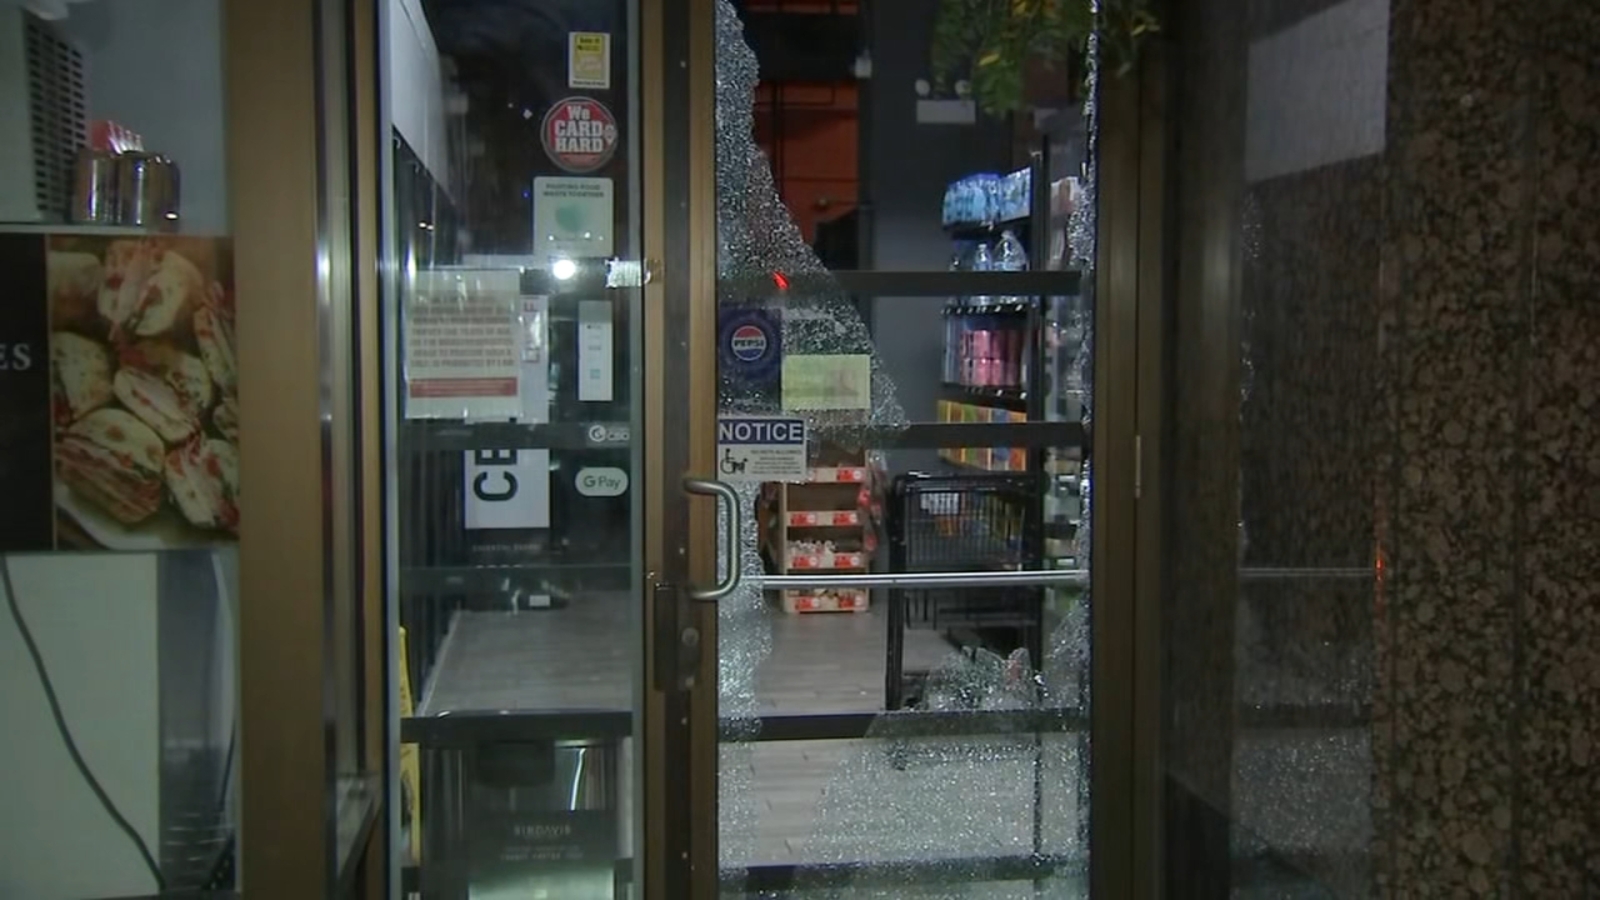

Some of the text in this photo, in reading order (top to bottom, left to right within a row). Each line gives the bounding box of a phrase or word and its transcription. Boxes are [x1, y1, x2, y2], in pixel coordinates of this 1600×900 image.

[566, 105, 590, 120] We
[554, 120, 602, 136] CARD
[555, 137, 603, 152] HARD
[734, 339, 764, 347] PEPSI
[718, 423, 802, 441] NOTICE
[599, 476, 621, 490] Pay
